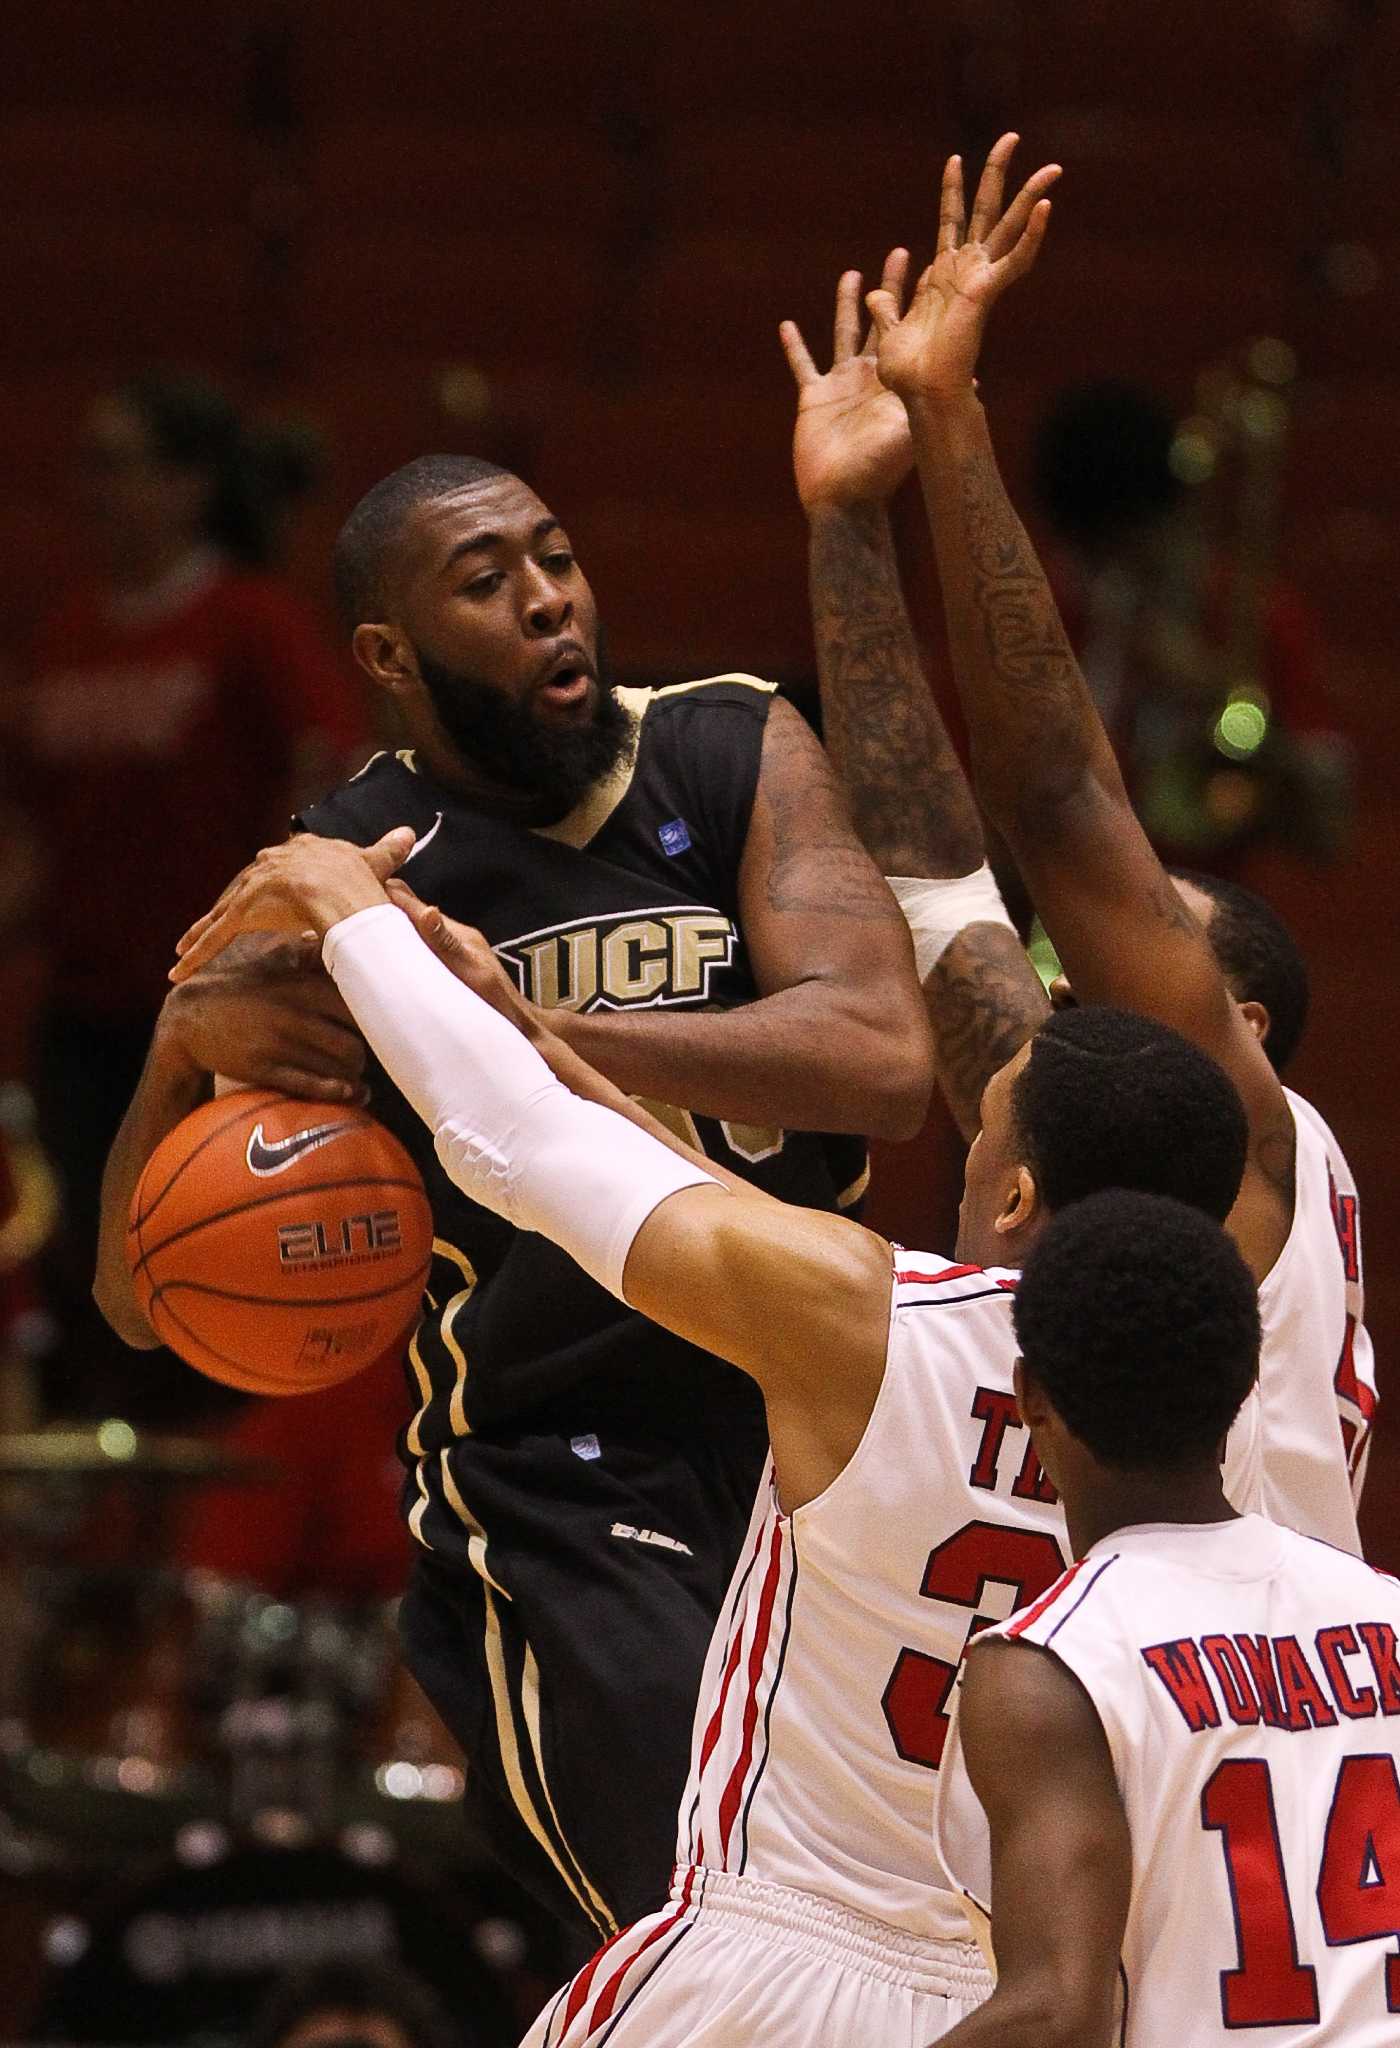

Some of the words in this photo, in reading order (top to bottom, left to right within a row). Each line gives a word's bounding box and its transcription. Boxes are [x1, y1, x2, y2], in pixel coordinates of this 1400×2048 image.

[519, 915, 733, 1012] UCF
[277, 1208, 402, 1265] ELITE
[1201, 1753, 1400, 2030] 14
